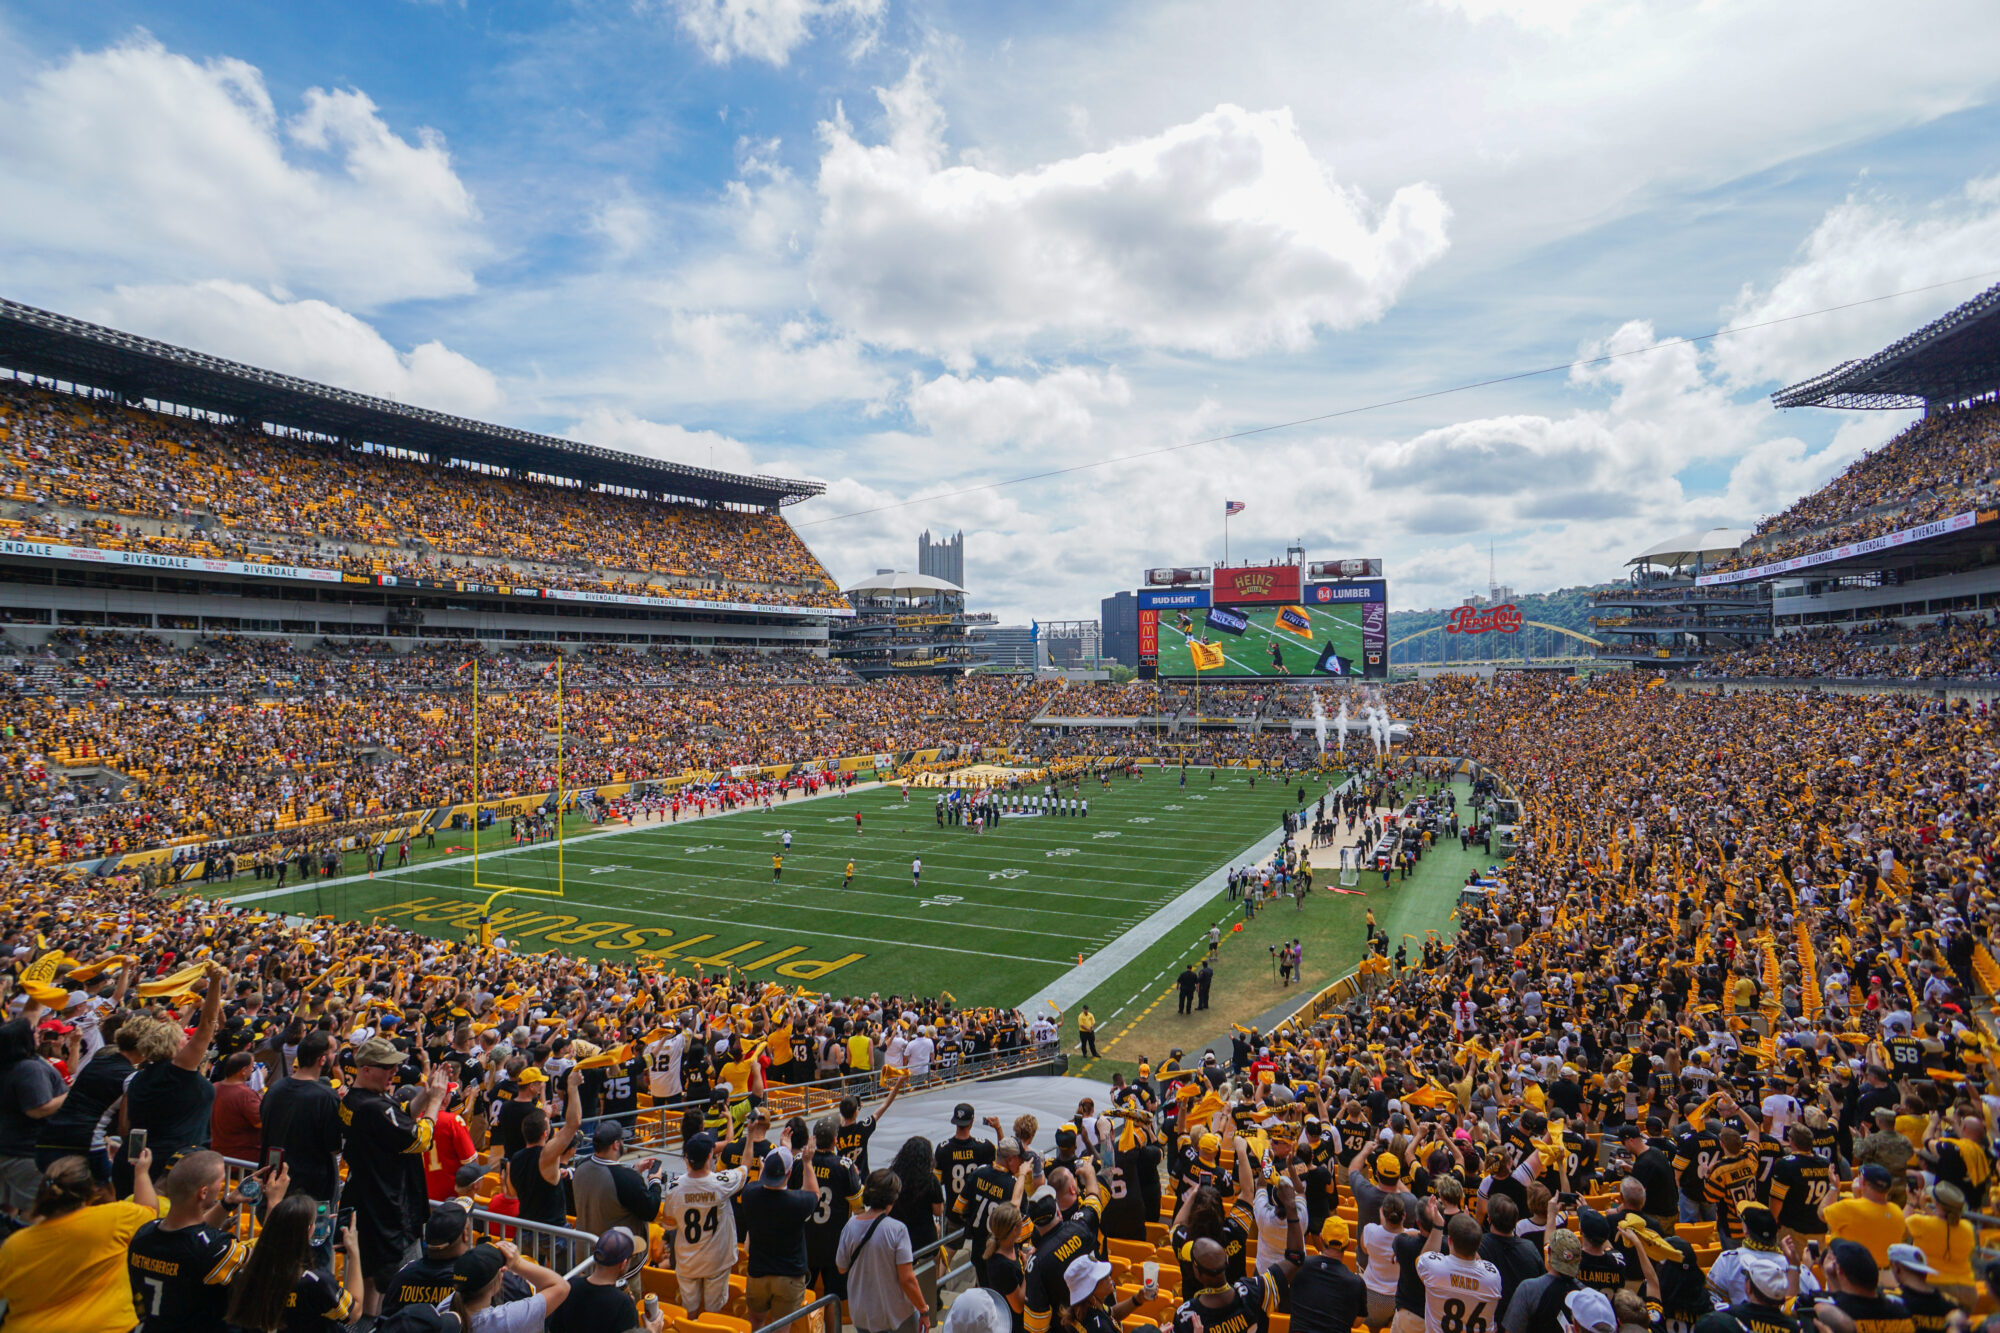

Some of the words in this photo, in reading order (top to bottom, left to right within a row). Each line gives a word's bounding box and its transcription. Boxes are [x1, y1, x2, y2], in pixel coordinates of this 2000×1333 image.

[1912, 521, 1946, 539] RIVENDALE
[1856, 537, 1886, 553] RIVENDALE
[122, 553, 189, 568] RIVENDALE
[1808, 550, 1833, 565] RIVENDALE
[243, 564, 298, 577] RIVENDALE
[342, 572, 371, 585] Steelers
[1234, 574, 1275, 588] HEINZ
[467, 583, 480, 593] 1ST
[515, 588, 539, 597] CHIEFS
[1317, 589, 1331, 599] 84
[1333, 588, 1371, 599] LUMBER
[585, 593, 619, 602] RIVENDALE
[1152, 597, 1170, 605] BUD
[1172, 596, 1196, 604] LIGHT
[704, 602, 733, 610] RIVENDALE
[757, 605, 784, 613] RIVENDALE
[364, 896, 868, 981] PITTSBURGH
[1459, 1011, 1470, 1020] 15
[1035, 1030, 1047, 1041] 43
[793, 1045, 808, 1062] 43
[964, 1041, 976, 1054] 79
[1894, 1046, 1919, 1064] 58
[649, 1054, 671, 1073] 12
[603, 1076, 632, 1100] 75
[385, 1106, 400, 1127] 7
[837, 1134, 862, 1151] AZE
[1344, 1135, 1364, 1151] 43
[952, 1149, 974, 1161] MILLER
[1759, 1156, 1774, 1182] 7
[684, 1191, 716, 1204] BROWN
[1805, 1180, 1828, 1205] 19
[683, 1205, 719, 1244] 84
[197, 1230, 211, 1245] 7
[1053, 1235, 1082, 1263] WARD
[131, 1252, 179, 1277] ROETHLISBERGER
[1450, 1273, 1480, 1291] WARD
[1576, 1270, 1620, 1284] LLANUEVA
[143, 1276, 164, 1317] 7
[1441, 1298, 1487, 1333] 86
